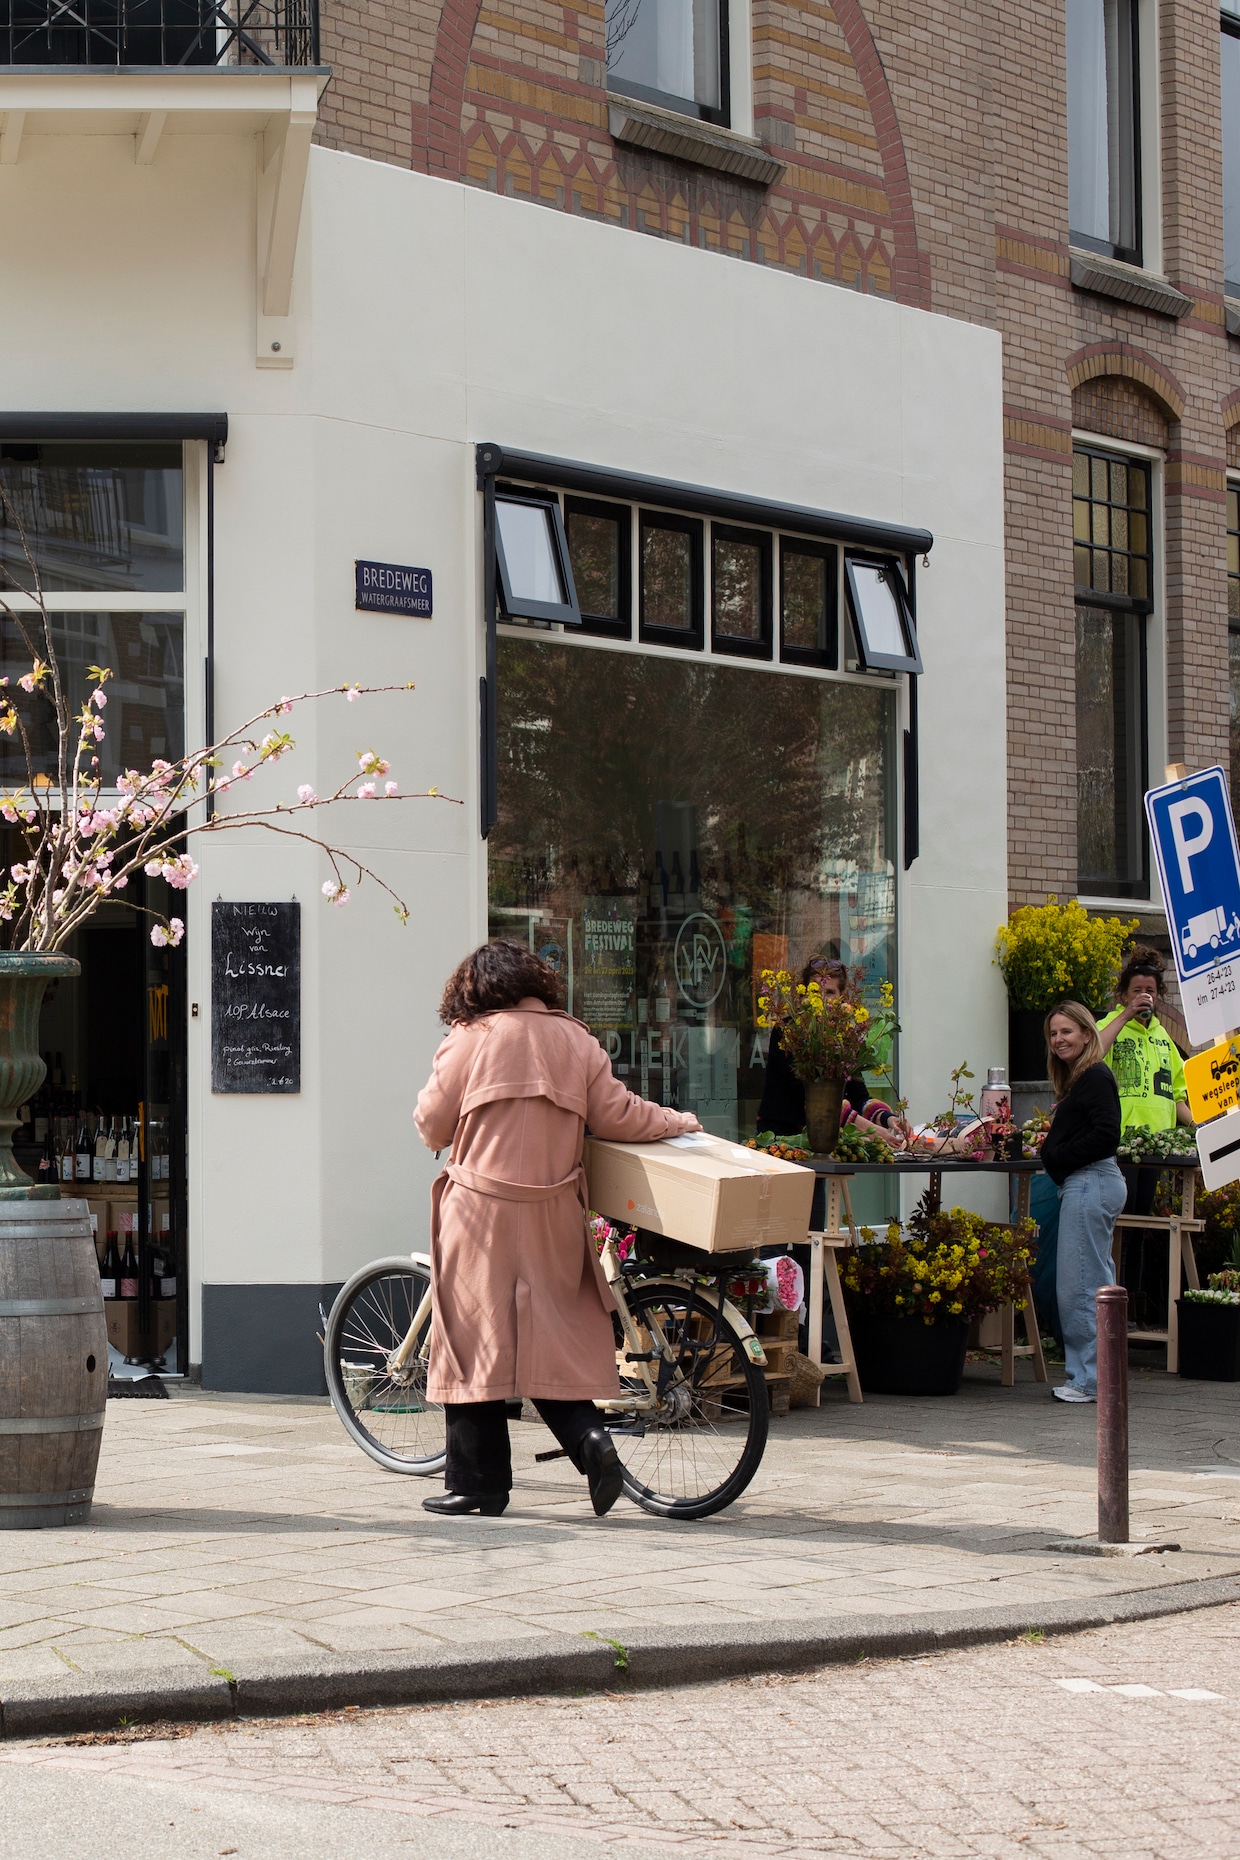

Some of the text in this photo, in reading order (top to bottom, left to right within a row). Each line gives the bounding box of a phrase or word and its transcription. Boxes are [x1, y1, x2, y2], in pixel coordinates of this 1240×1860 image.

[363, 567, 427, 593] BREDEWEG
[361, 592, 430, 611] WATERGRAAFSMEER
[1167, 796, 1214, 894] P
[585, 921, 634, 933] BREDEWEG
[585, 935, 634, 950] FESTIVAL
[1197, 994, 1208, 1006] t/m
[247, 1003, 290, 1019] Alsace
[606, 1031, 767, 1069] PIEKA
[1217, 1095, 1234, 1109] van
